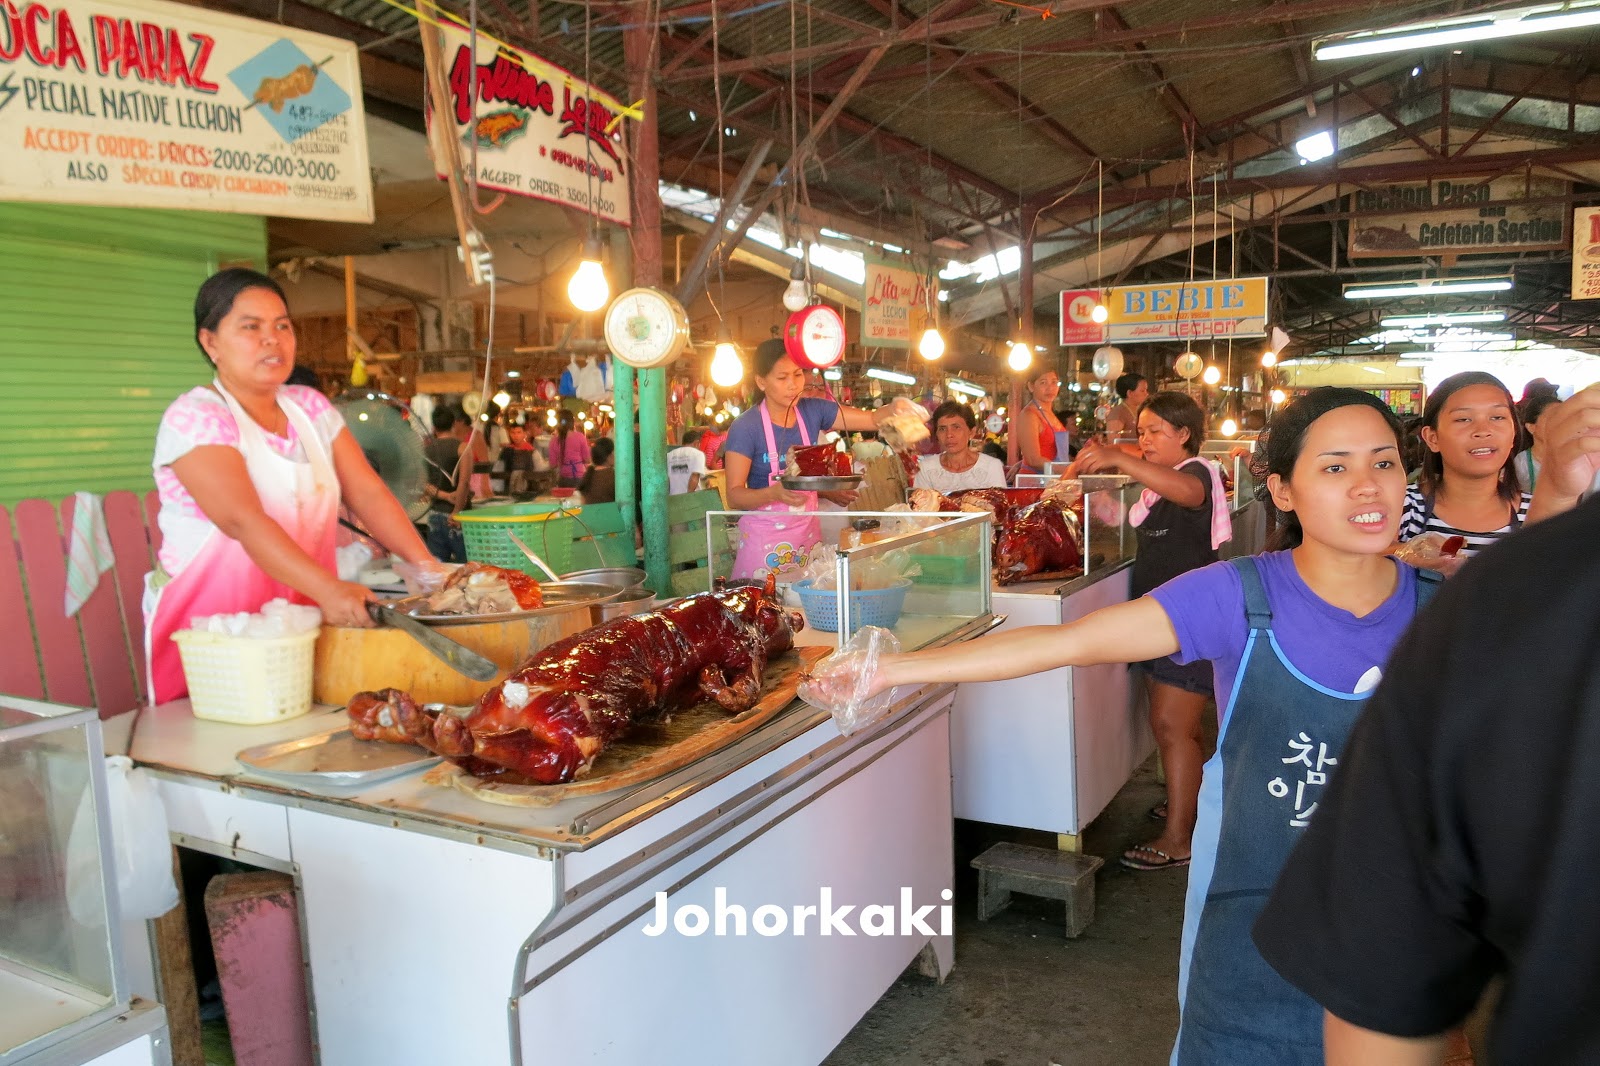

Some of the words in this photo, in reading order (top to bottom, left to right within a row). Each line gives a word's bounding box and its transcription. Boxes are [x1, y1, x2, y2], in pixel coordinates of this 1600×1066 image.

[89, 14, 220, 94] PARAZ
[100, 87, 171, 126] NATIVE
[176, 97, 242, 134] LECHON
[24, 126, 92, 156] ACCEPT
[67, 160, 108, 182] ALSO
[481, 166, 522, 188] ACCEPT
[1419, 221, 1494, 246] Cafeteria
[1498, 218, 1562, 243] Section
[1123, 284, 1245, 316] BEBIE
